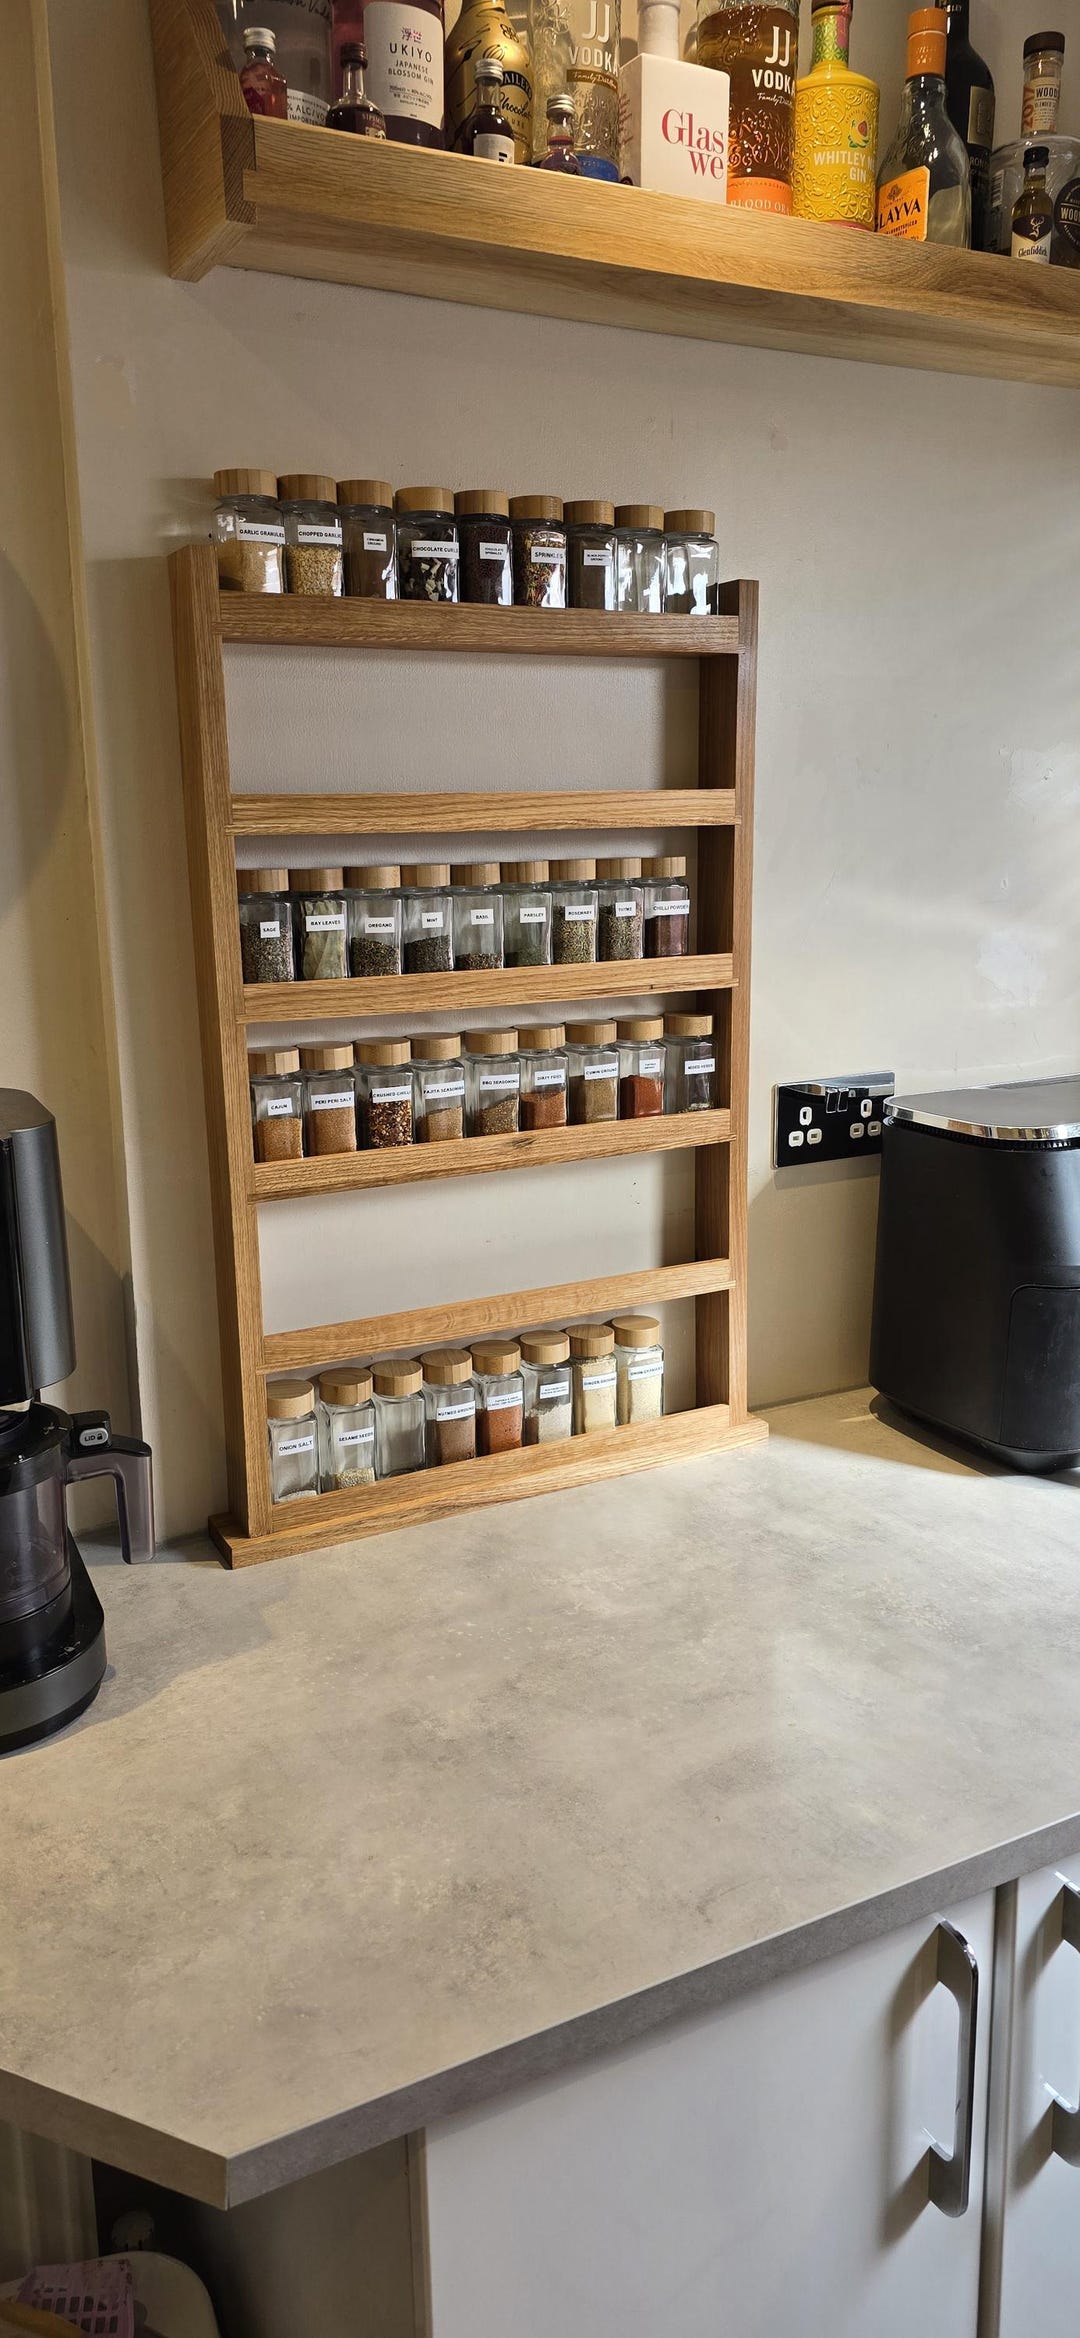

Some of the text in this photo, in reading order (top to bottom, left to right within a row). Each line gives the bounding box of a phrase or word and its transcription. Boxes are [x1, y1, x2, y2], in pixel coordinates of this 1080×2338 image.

[389, 42, 432, 63] UKIYO
[765, 26, 790, 67] JJ
[395, 59, 428, 75] JAPANESE
[568, 46, 619, 78] VODKA
[388, 67, 434, 86] BLOSSOM GIN
[503, 71, 532, 98] AILEYS
[752, 69, 795, 97] VODKA
[662, 109, 724, 155] Glas
[687, 150, 724, 180] we
[814, 150, 866, 168] WHITLEY
[849, 166, 867, 184] GIN
[534, 551, 564, 559] SPRINKLES
[493, 1078, 518, 1086] SEASONING
[270, 1103, 288, 1111] CAJUN
[438, 1410, 457, 1418] NUTMEG
[84, 1434, 96, 1442] LID
[359, 1431, 374, 1439] SEEDS
[279, 1440, 313, 1452] ONION SALT
